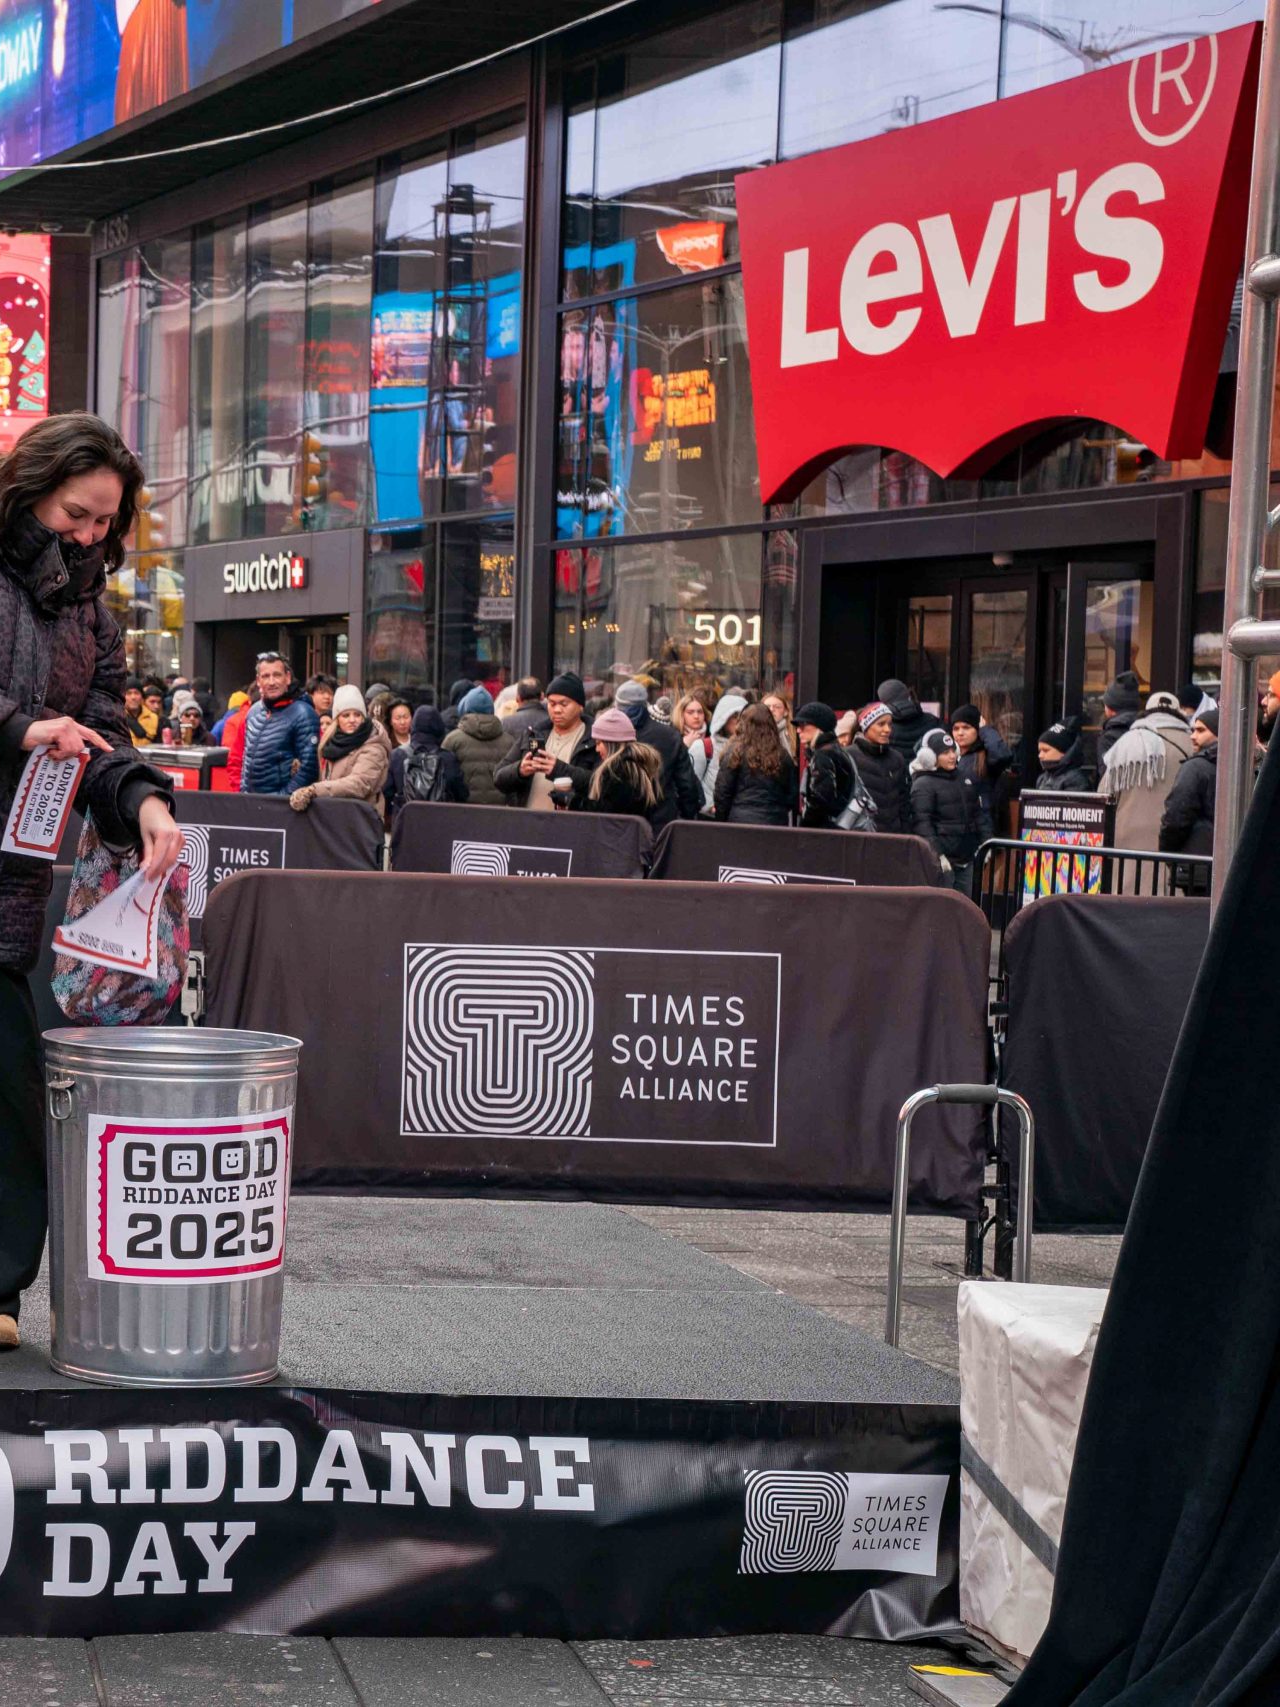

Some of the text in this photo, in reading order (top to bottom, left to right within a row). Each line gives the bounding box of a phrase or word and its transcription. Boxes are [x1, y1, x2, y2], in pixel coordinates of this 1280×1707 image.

[223, 551, 292, 594] swatch
[693, 614, 761, 646] 501
[35, 772, 45, 791] NEXT
[44, 773, 58, 791] TO
[53, 761, 75, 806] ADMIT
[29, 792, 39, 807] ACT
[33, 794, 51, 823] 2026
[20, 808, 34, 835] BEGINS
[42, 808, 59, 837] ONE
[1023, 805, 1104, 823] MIDNIGHT MOMENT
[219, 847, 270, 866] TIMES
[624, 993, 745, 1027] TIMES
[610, 1034, 758, 1071] SQUARE
[619, 1077, 749, 1103] ALLIANCE
[122, 1135, 278, 1184] GOOD
[122, 1179, 278, 1205] RIDDANCE DAY
[126, 1205, 274, 1260] 2025
[43, 1427, 596, 1512] RIDDANCE
[865, 1495, 928, 1512] TIMES
[851, 1516, 930, 1535] SQUARE
[851, 1538, 921, 1551] ALLIANCE
[42, 1521, 256, 1597] DAY
